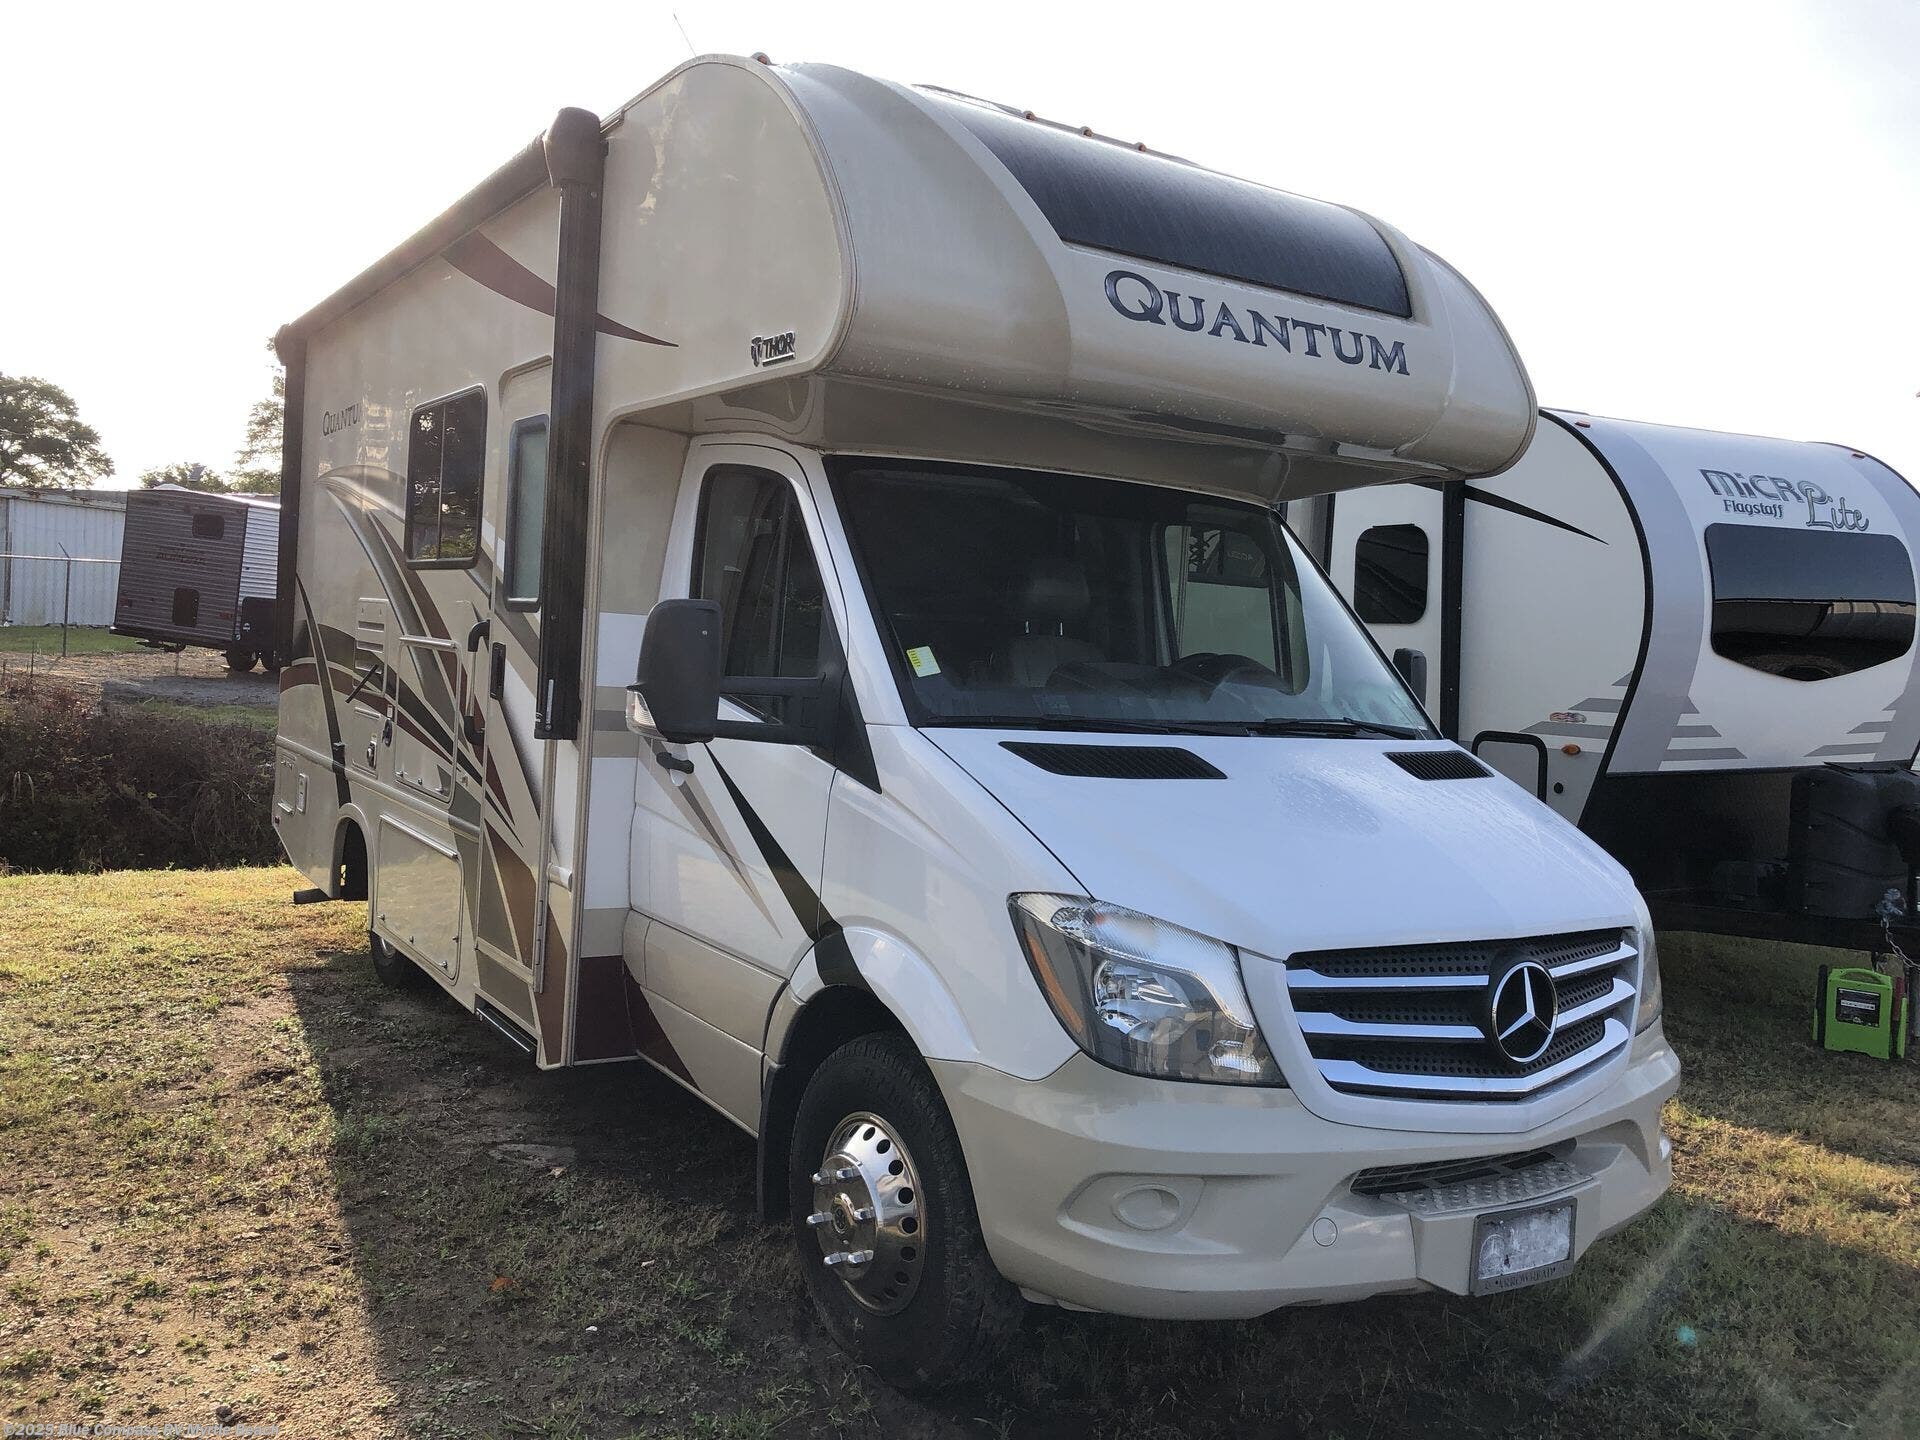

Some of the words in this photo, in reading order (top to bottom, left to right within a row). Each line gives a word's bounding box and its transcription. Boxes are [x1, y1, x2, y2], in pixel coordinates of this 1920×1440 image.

[1104, 269, 1410, 376] QUANTUM
[762, 331, 795, 359] THOR
[1723, 498, 1784, 518] Flagstaff
[1805, 487, 1869, 531] Lite
